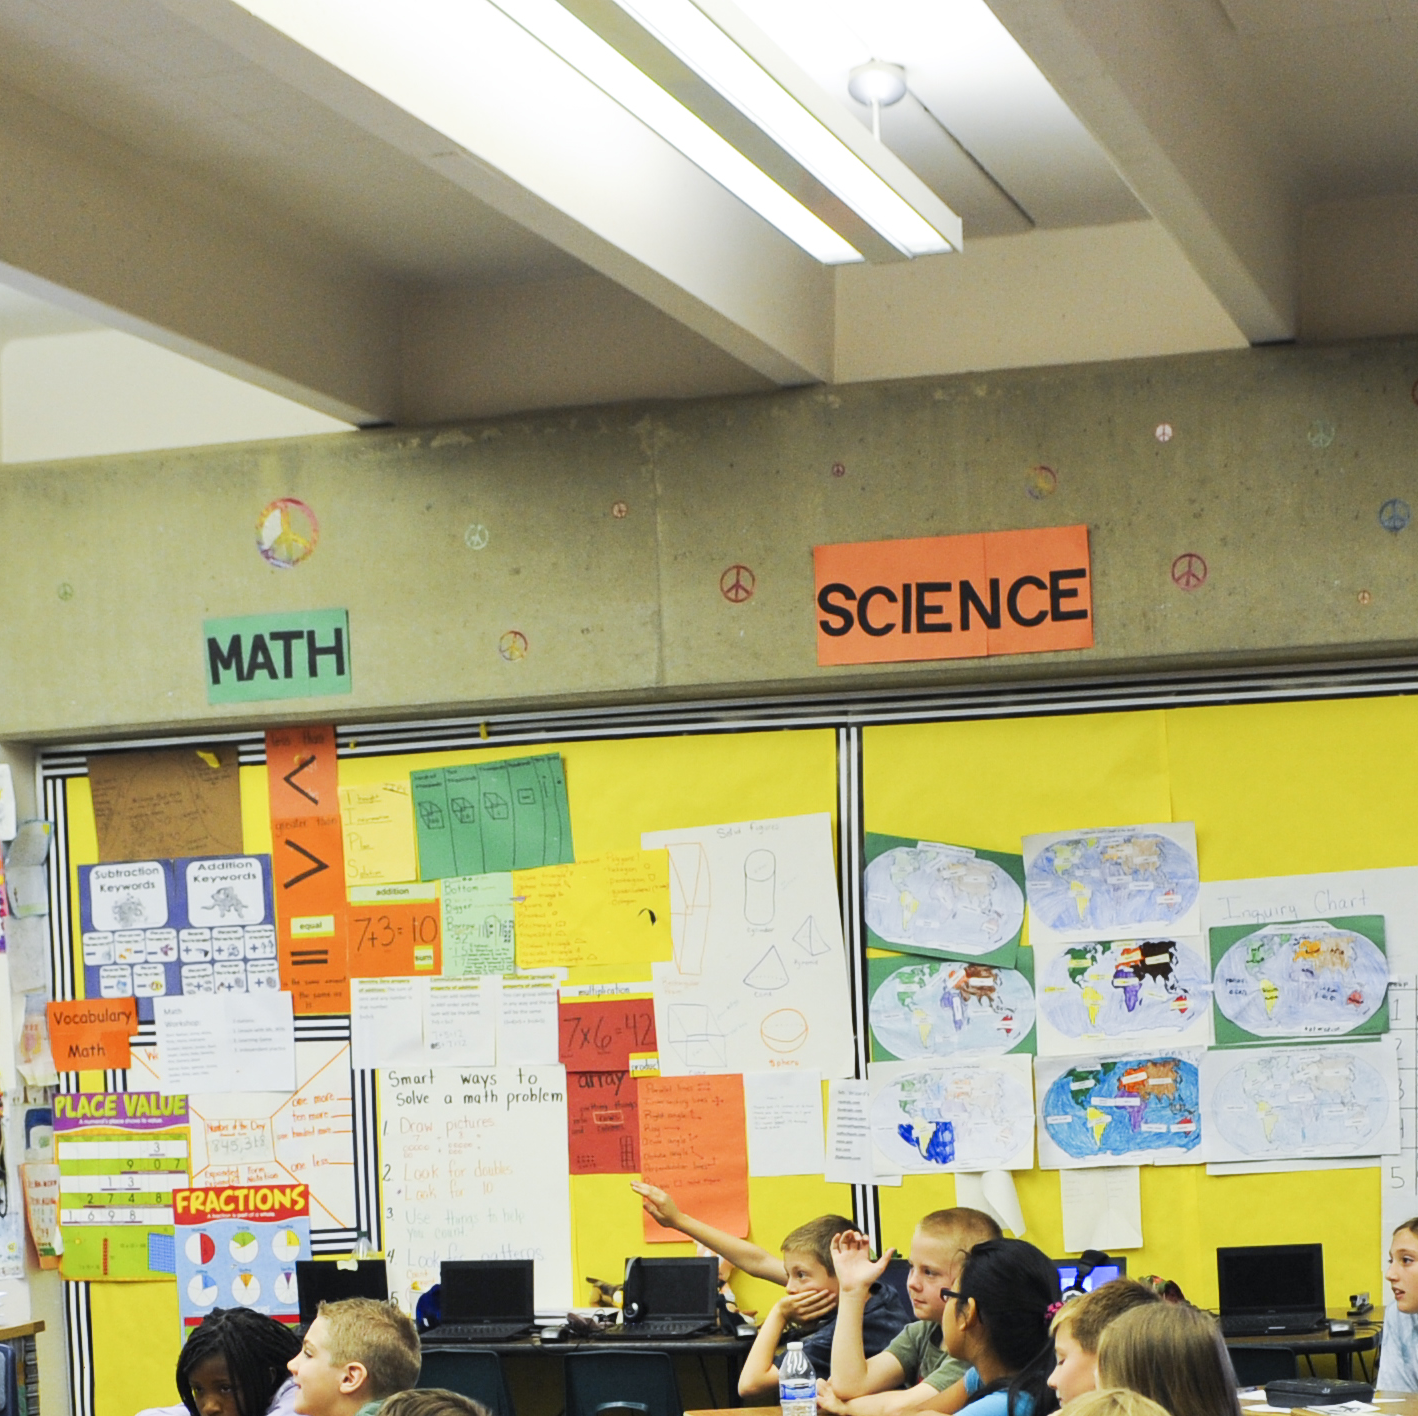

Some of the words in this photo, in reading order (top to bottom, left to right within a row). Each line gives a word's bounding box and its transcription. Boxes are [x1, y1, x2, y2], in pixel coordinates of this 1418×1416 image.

[819, 569, 1088, 637] SCIENCE
[209, 629, 345, 684] MATH
[94, 865, 159, 879] Subtraction
[198, 860, 253, 871] Addition
[193, 872, 257, 882] Keywords
[99, 881, 155, 894] Keywords
[376, 887, 409, 895] addition
[1218, 897, 1297, 923] Inquiry
[1314, 889, 1370, 914] Chart
[299, 922, 322, 930] equal
[578, 986, 630, 996] multiplication
[54, 1010, 131, 1025] Vocabulary
[68, 1043, 105, 1058] Math
[388, 1069, 435, 1087] Smart
[461, 1073, 497, 1094] ways
[517, 1067, 537, 1085] to
[54, 1094, 117, 1119] PLACE
[123, 1093, 187, 1117] VALUE
[314, 1093, 334, 1104] more
[397, 1090, 429, 1106] Solve
[444, 1093, 452, 1104] a
[463, 1088, 498, 1104] math
[507, 1086, 563, 1111] problem
[309, 1111, 328, 1119] more
[400, 1117, 433, 1134] Draw
[446, 1116, 494, 1138] pictures
[404, 1163, 438, 1182] Look
[449, 1160, 466, 1178] for
[474, 1161, 513, 1178] doubles
[1391, 1166, 1405, 1189] 5
[404, 1185, 436, 1201] Look
[483, 1181, 493, 1195] 10
[175, 1185, 306, 1215] FRACTIONS
[405, 1209, 430, 1225] Use
[445, 1210, 479, 1226] things
